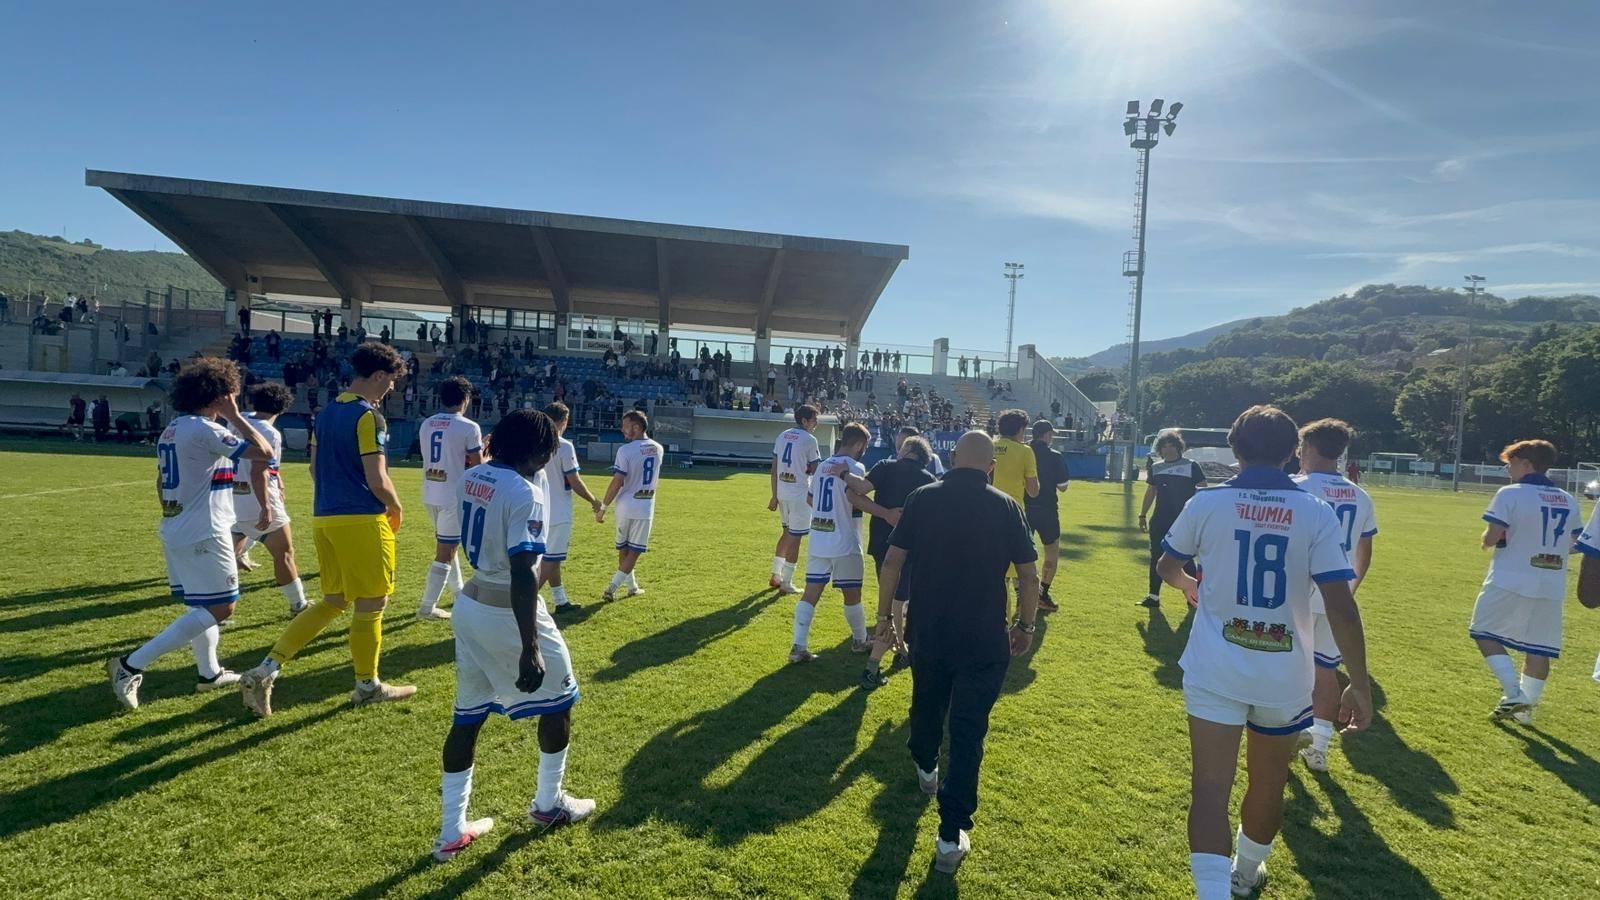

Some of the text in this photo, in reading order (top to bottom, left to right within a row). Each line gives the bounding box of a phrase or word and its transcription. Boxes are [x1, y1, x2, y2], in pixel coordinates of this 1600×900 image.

[430, 431, 443, 463] 6
[782, 442, 793, 468] 4
[642, 457, 655, 485] 8
[817, 477, 834, 513] 16
[461, 500, 487, 569] 19
[1541, 506, 1570, 548] 17
[1235, 529, 1289, 609] 18
